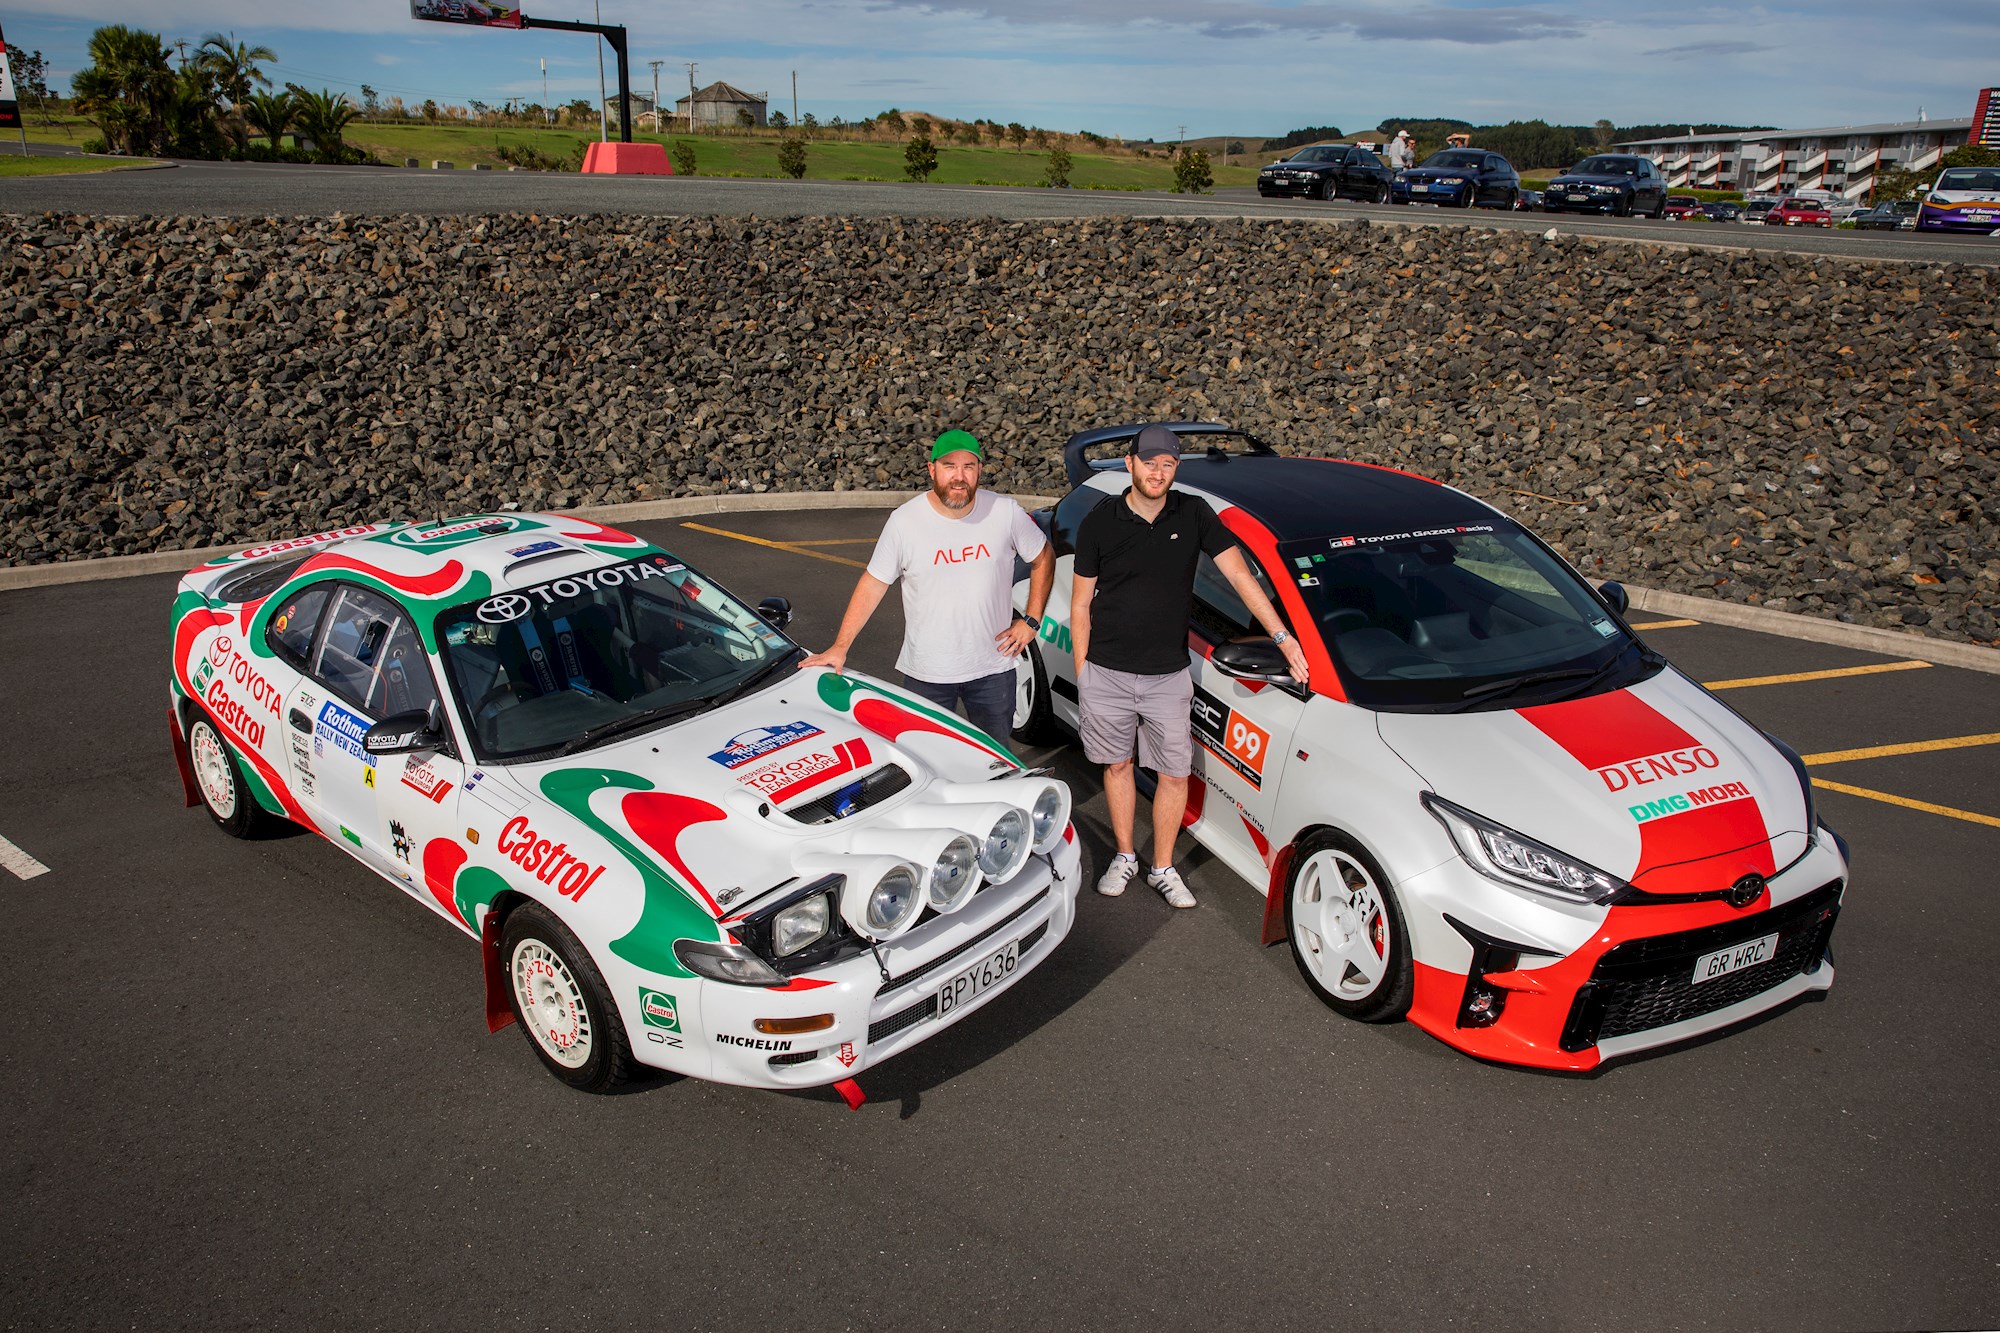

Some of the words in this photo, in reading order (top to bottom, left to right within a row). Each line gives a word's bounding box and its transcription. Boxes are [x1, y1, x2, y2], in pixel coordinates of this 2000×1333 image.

[242, 524, 377, 560] Castrol
[420, 517, 505, 540] Castrol
[1331, 539, 1356, 549] GR
[1357, 533, 1411, 544] TOYOTA
[1456, 525, 1493, 534] Racing
[933, 543, 991, 565] ALFA
[528, 562, 666, 604] TOYOTA
[228, 651, 282, 721] TOYOTA
[208, 679, 266, 750] Castrol
[323, 705, 368, 743] Rothma
[315, 722, 335, 741] RALLY
[334, 734, 350, 751] NEW
[349, 742, 378, 768] ZEALAND
[367, 735, 397, 743] TOYOTA
[725, 752, 756, 767] RALLY
[757, 743, 777, 755] NEW
[779, 728, 817, 747] ZEALAND
[731, 730, 796, 757] Rothmans
[1233, 722, 1261, 761] 99
[365, 769, 374, 788] A
[403, 771, 415, 782] TEAM
[414, 777, 431, 792] EUROPE
[405, 761, 435, 786] TOYOTA
[736, 763, 771, 783] PREPARED
[770, 761, 779, 769] BY
[744, 752, 831, 789] TOYOTA
[758, 776, 794, 796] TEAM
[793, 756, 840, 782] EUROPE
[1597, 747, 1720, 793] DENSO
[1207, 777, 1235, 804] GAZOO
[1236, 801, 1265, 832] Racing
[1628, 794, 1690, 822] DMG
[1686, 781, 1750, 806] MORI
[497, 816, 607, 903] Castrol
[1707, 953, 1730, 977] GR
[1732, 941, 1766, 969] WRC
[941, 946, 1016, 1014] BPY636
[647, 1004, 674, 1019] Castrol
[716, 1033, 792, 1051] MICHELIN
[843, 1044, 853, 1065] TOW
